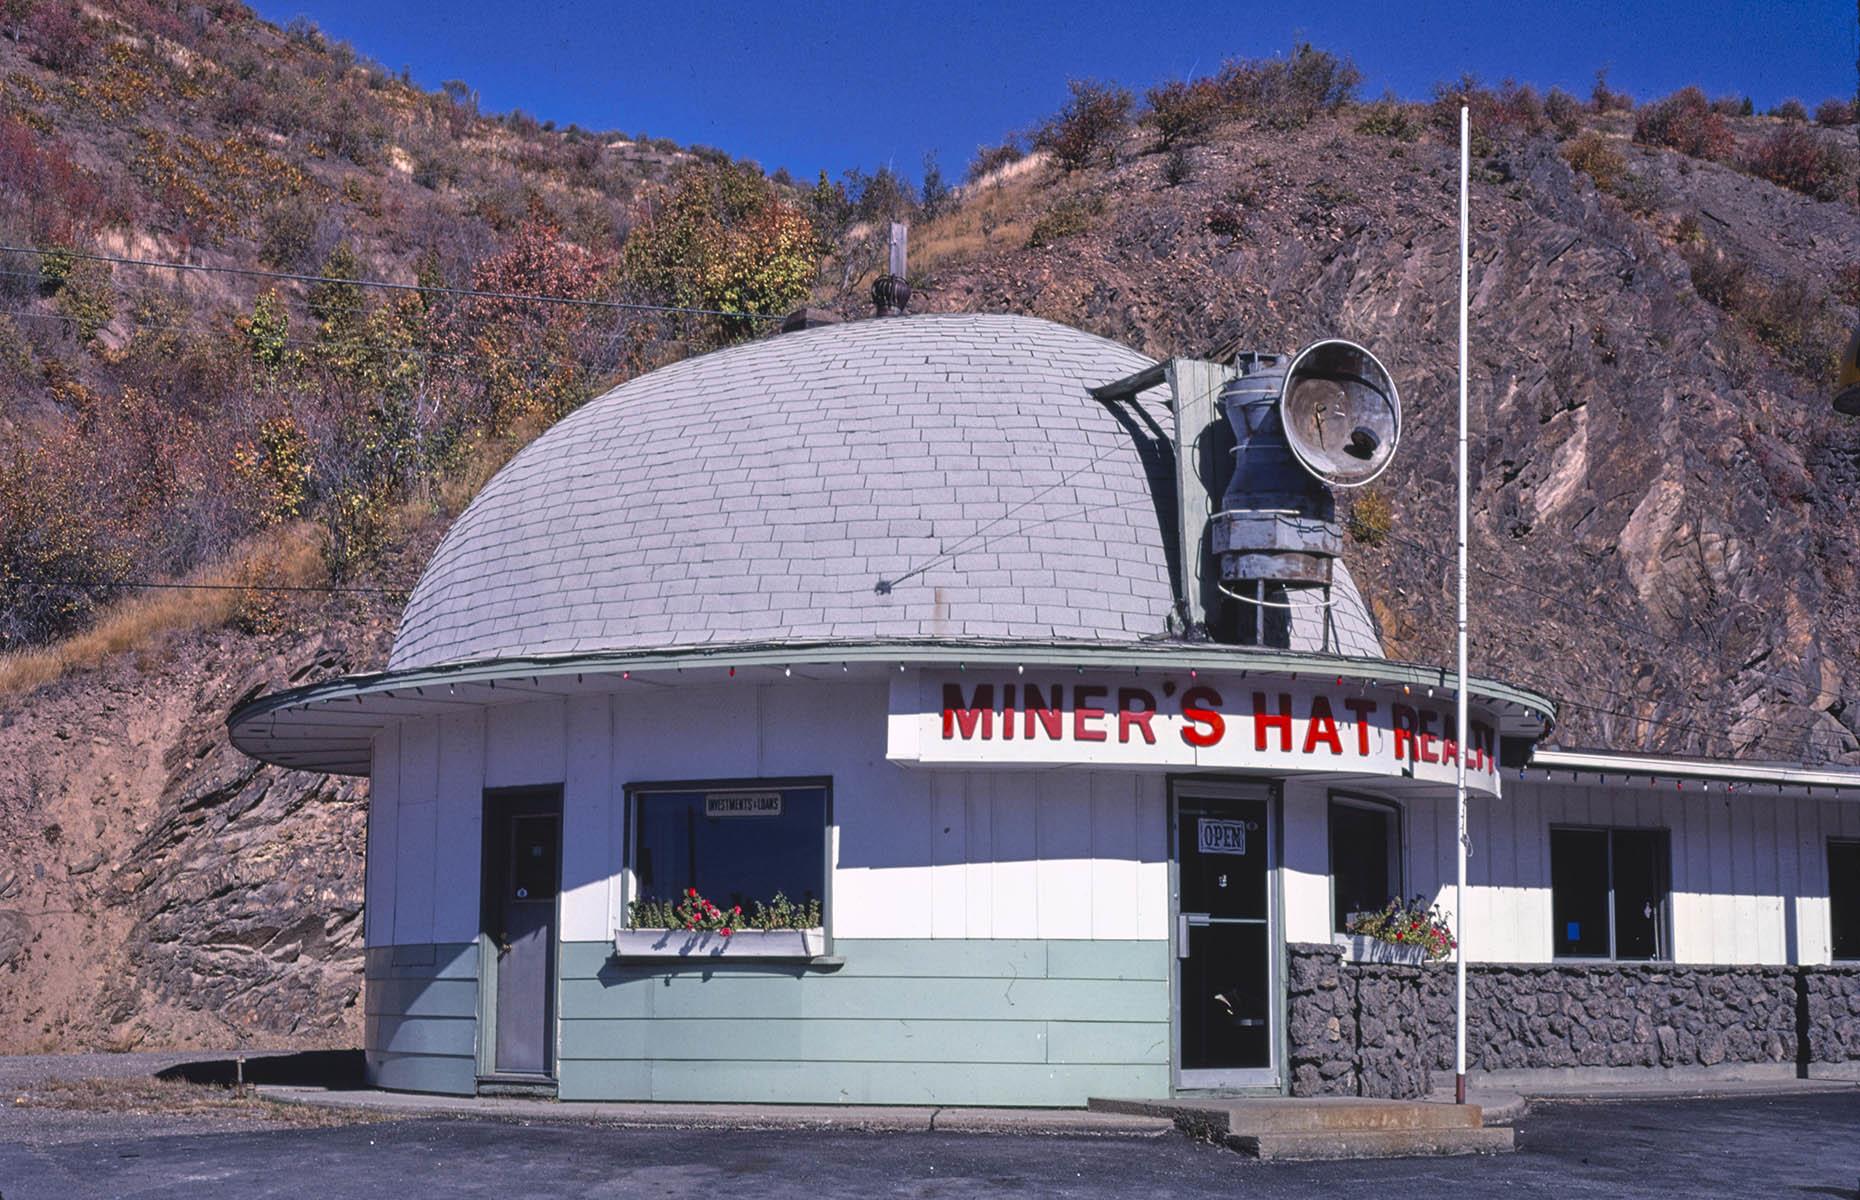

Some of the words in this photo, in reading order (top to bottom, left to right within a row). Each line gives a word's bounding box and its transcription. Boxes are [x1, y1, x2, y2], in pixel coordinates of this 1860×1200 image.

[942, 681, 1226, 748] MINER'S
[1252, 691, 1378, 757] HAT
[708, 798, 753, 811] INVESTMENTS
[758, 797, 779, 810] LOANS
[1204, 825, 1242, 848] OPEN
